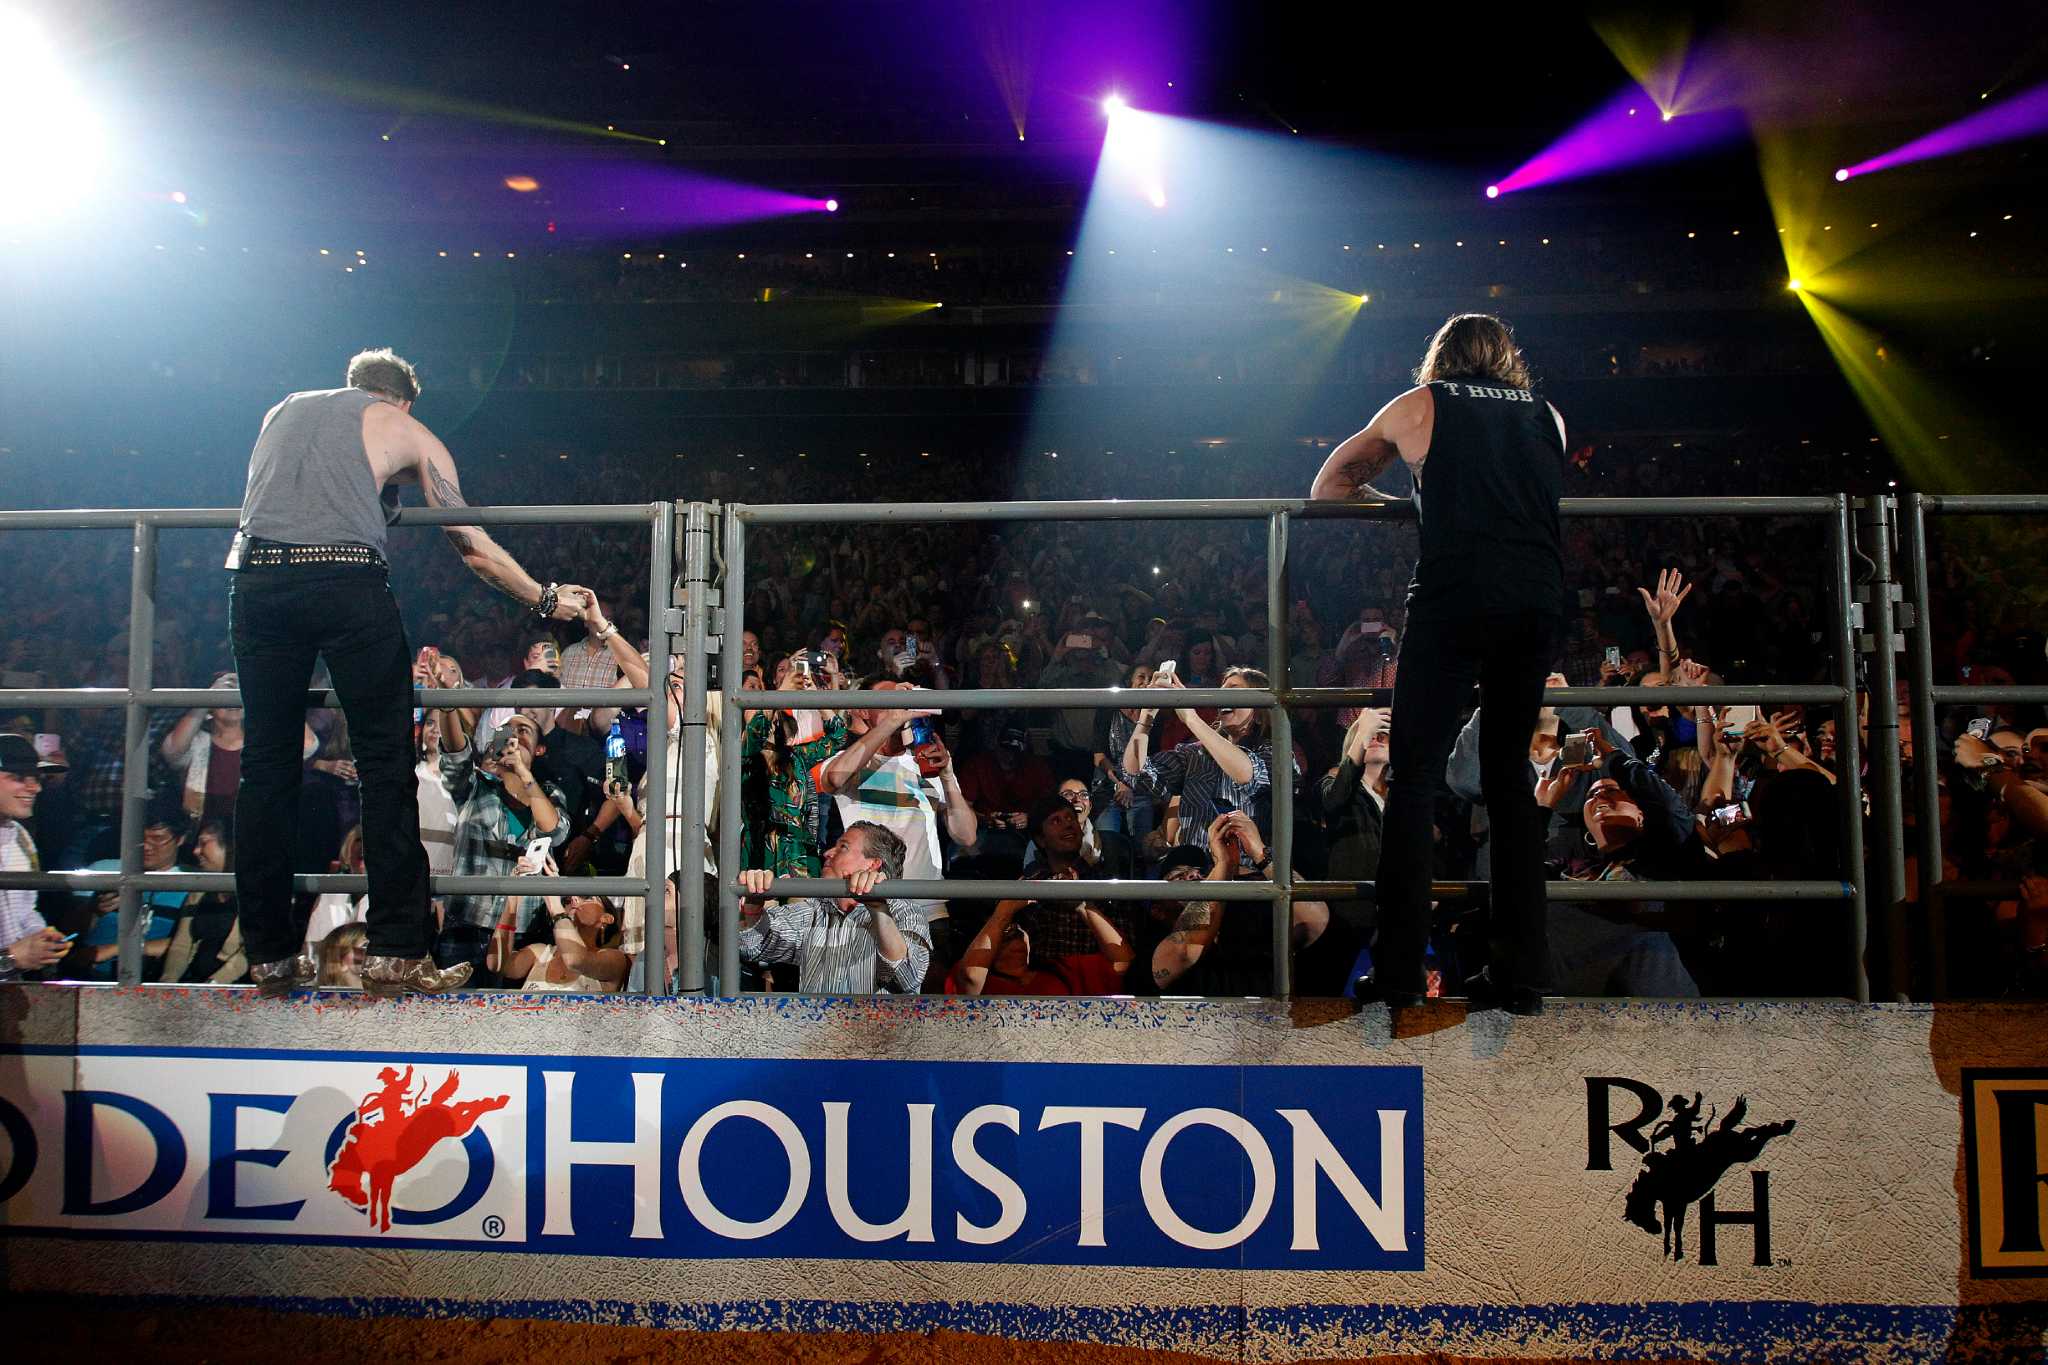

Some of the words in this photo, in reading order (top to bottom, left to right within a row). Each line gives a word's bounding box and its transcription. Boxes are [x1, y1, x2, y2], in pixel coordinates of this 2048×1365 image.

[1442, 382, 1460, 396] T
[0, 1090, 495, 1226] DEO
[540, 1071, 1409, 1252] HOUSTON
